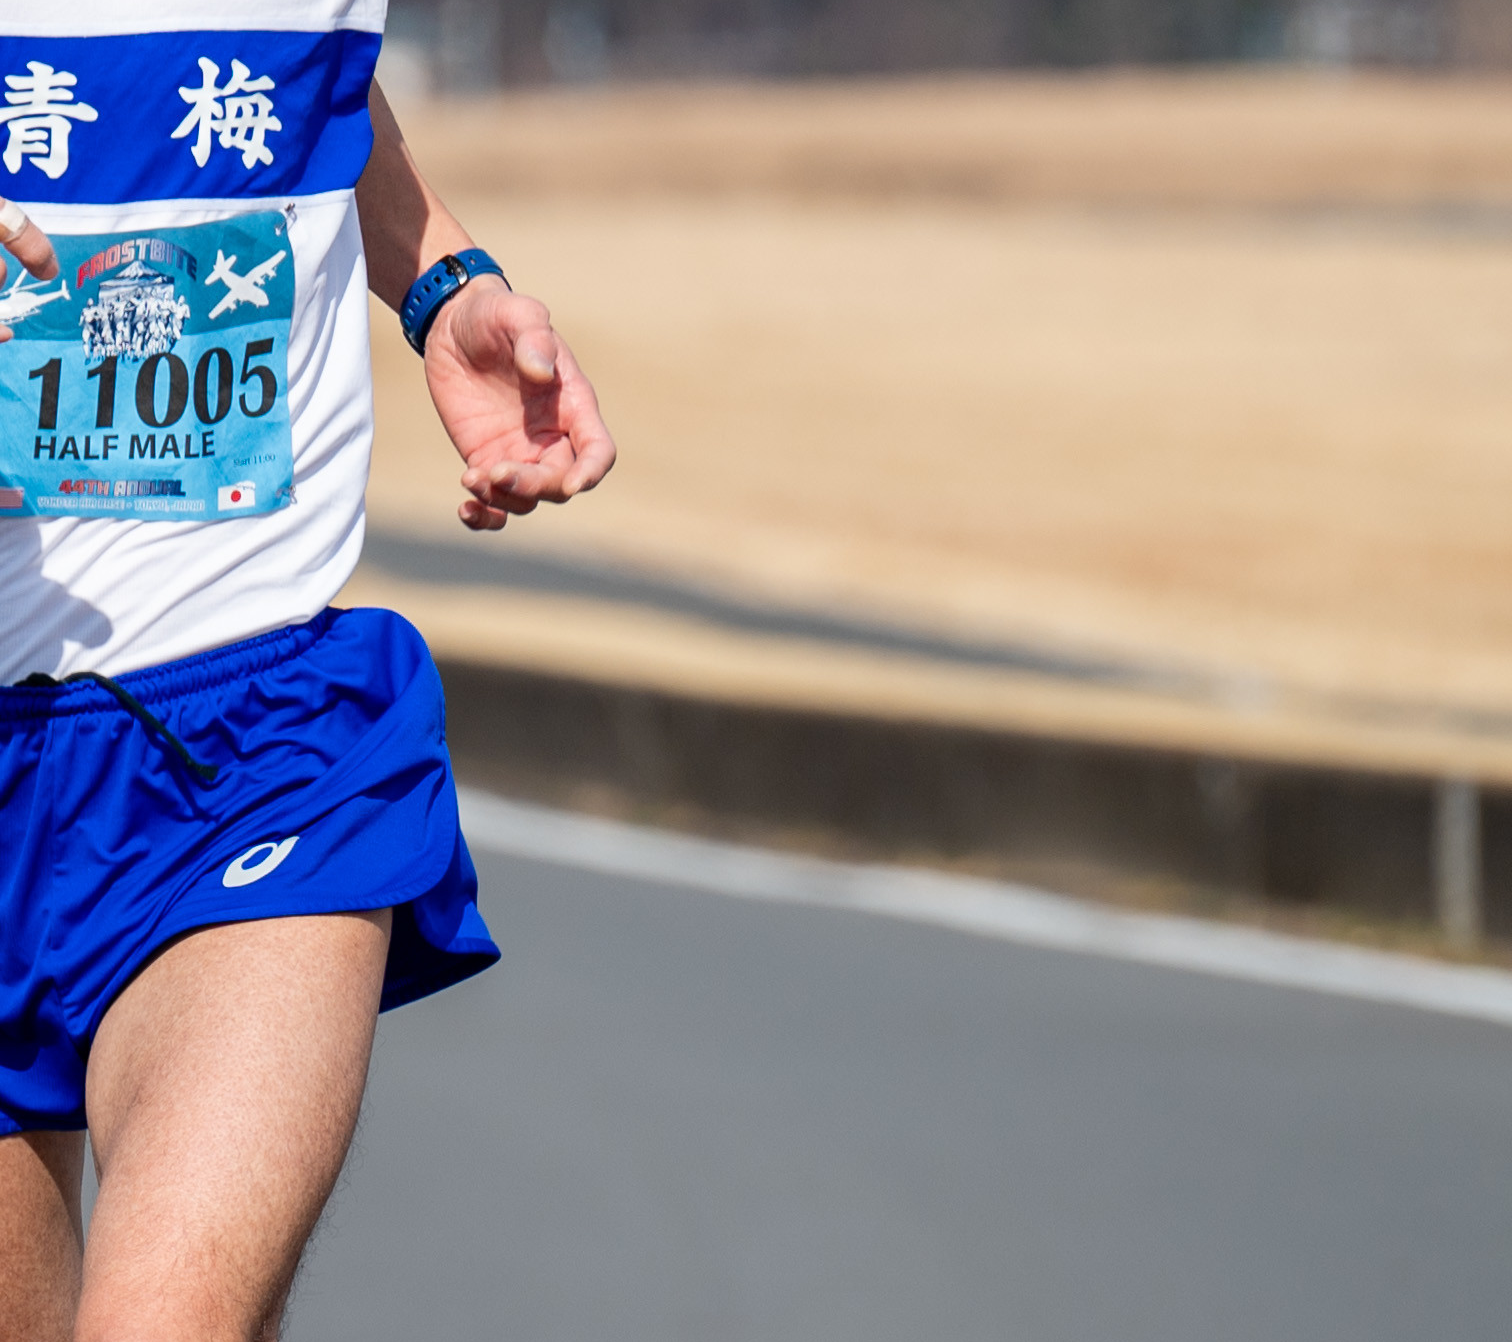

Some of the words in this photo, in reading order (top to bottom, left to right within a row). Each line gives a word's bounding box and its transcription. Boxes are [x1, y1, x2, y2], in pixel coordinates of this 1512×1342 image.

[76, 238, 198, 289] FROSTBITE
[28, 337, 278, 430] 11005
[33, 435, 119, 460] HALF
[128, 430, 216, 460] MALE
[58, 478, 110, 496] 44TH
[114, 479, 186, 497] ANNUAL
